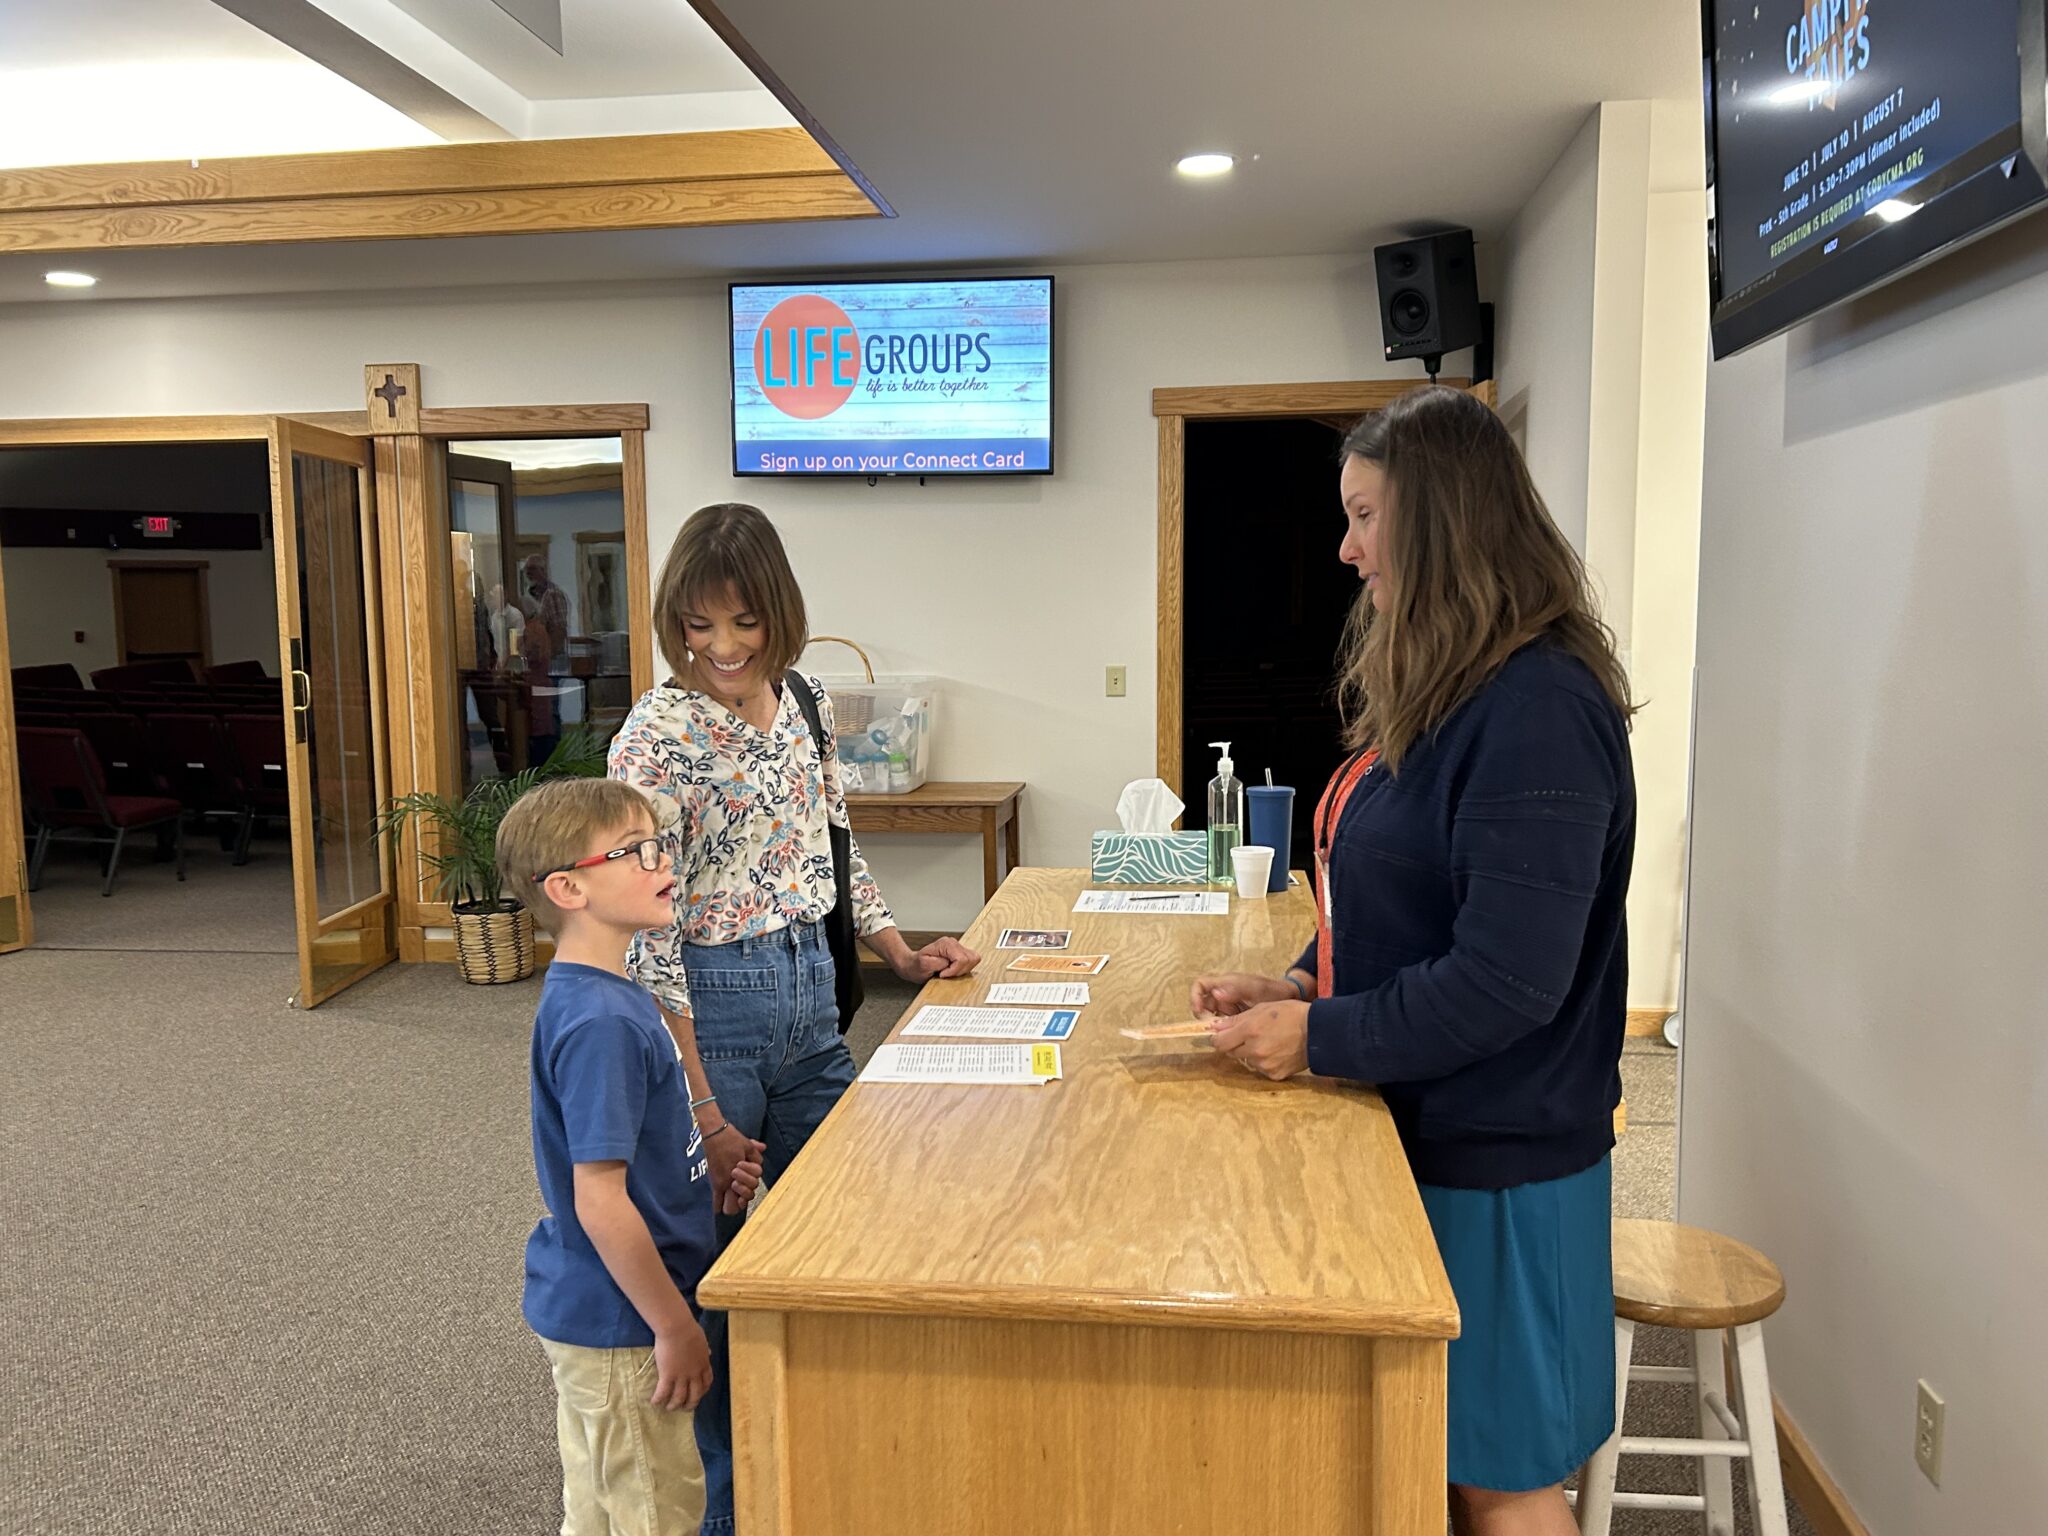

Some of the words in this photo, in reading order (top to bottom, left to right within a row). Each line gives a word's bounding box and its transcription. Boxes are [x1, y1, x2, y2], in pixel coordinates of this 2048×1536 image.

[1805, 15, 1870, 112] TALES
[1783, 167, 1799, 192] JUNE
[1801, 160, 1809, 178] 12
[1821, 137, 1838, 164] JULY
[1840, 129, 1849, 150] 10
[1863, 94, 1895, 134] AUGUST
[1898, 87, 1903, 107] 7
[1790, 192, 1809, 217] Grade
[1867, 131, 1897, 165] (dinner
[1900, 97, 1941, 142] included)
[1770, 220, 1811, 260] REGISTRATION
[1812, 215, 1820, 232] IS
[1821, 193, 1854, 228] REQUIRED
[1855, 185, 1865, 205] AT
[1866, 147, 1924, 198] CODYCMA.ORG
[762, 326, 855, 389] LIFE
[865, 332, 991, 375] GROUPS
[866, 377, 884, 399] life
[887, 379, 898, 392] is
[902, 377, 936, 392] better
[939, 376, 989, 398] together
[760, 452, 799, 472] Sign
[804, 456, 827, 472] up
[831, 456, 854, 469] on
[858, 455, 898, 472] your
[903, 452, 978, 468] Connect
[982, 450, 1025, 467] Card
[148, 517, 169, 532] EXIT
